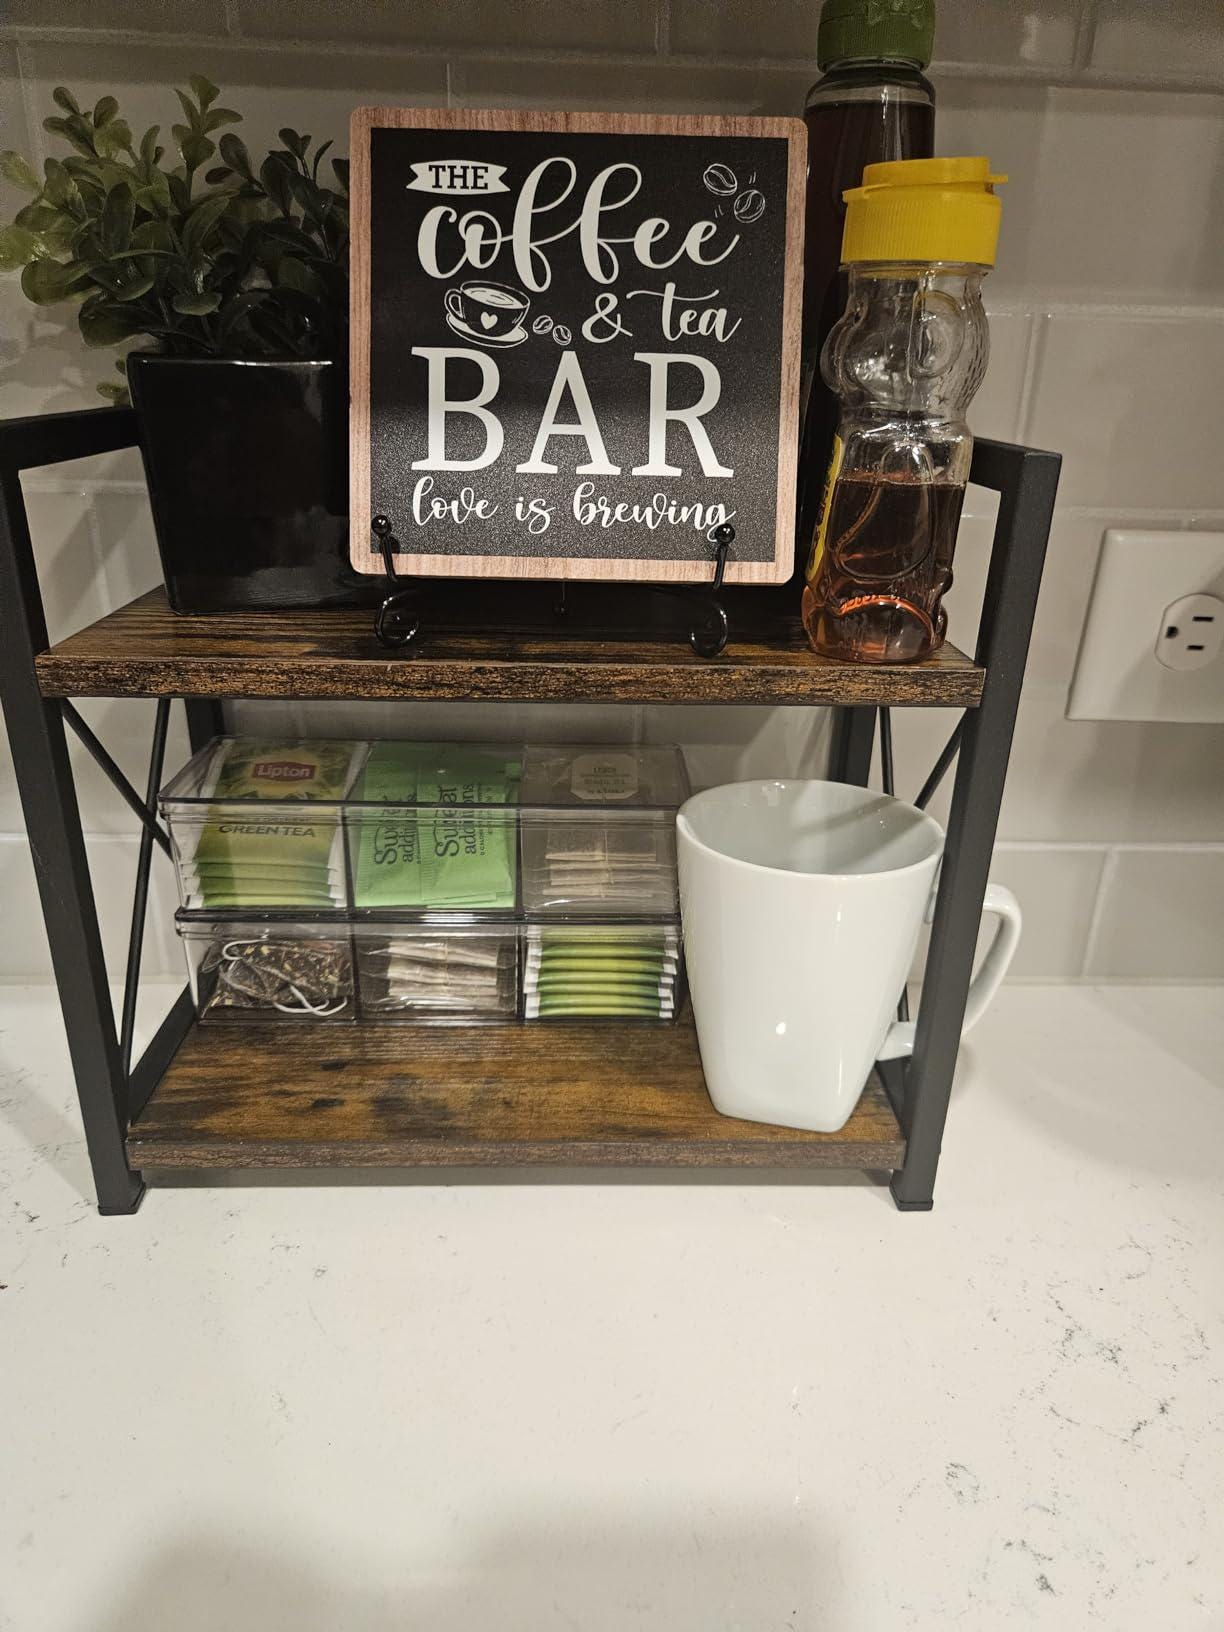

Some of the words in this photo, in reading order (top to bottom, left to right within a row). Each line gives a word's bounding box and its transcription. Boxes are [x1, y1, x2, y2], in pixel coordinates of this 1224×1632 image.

[428, 164, 489, 190] THE
[417, 157, 740, 292] coffee
[581, 293, 633, 343] &
[626, 282, 742, 342] tea
[411, 346, 735, 478] BAR
[412, 476, 498, 526] love
[516, 495, 555, 534] is
[573, 481, 736, 542] brewing
[256, 764, 311, 779] Lipton
[218, 825, 282, 836] GREEN
[281, 826, 316, 838] TEA
